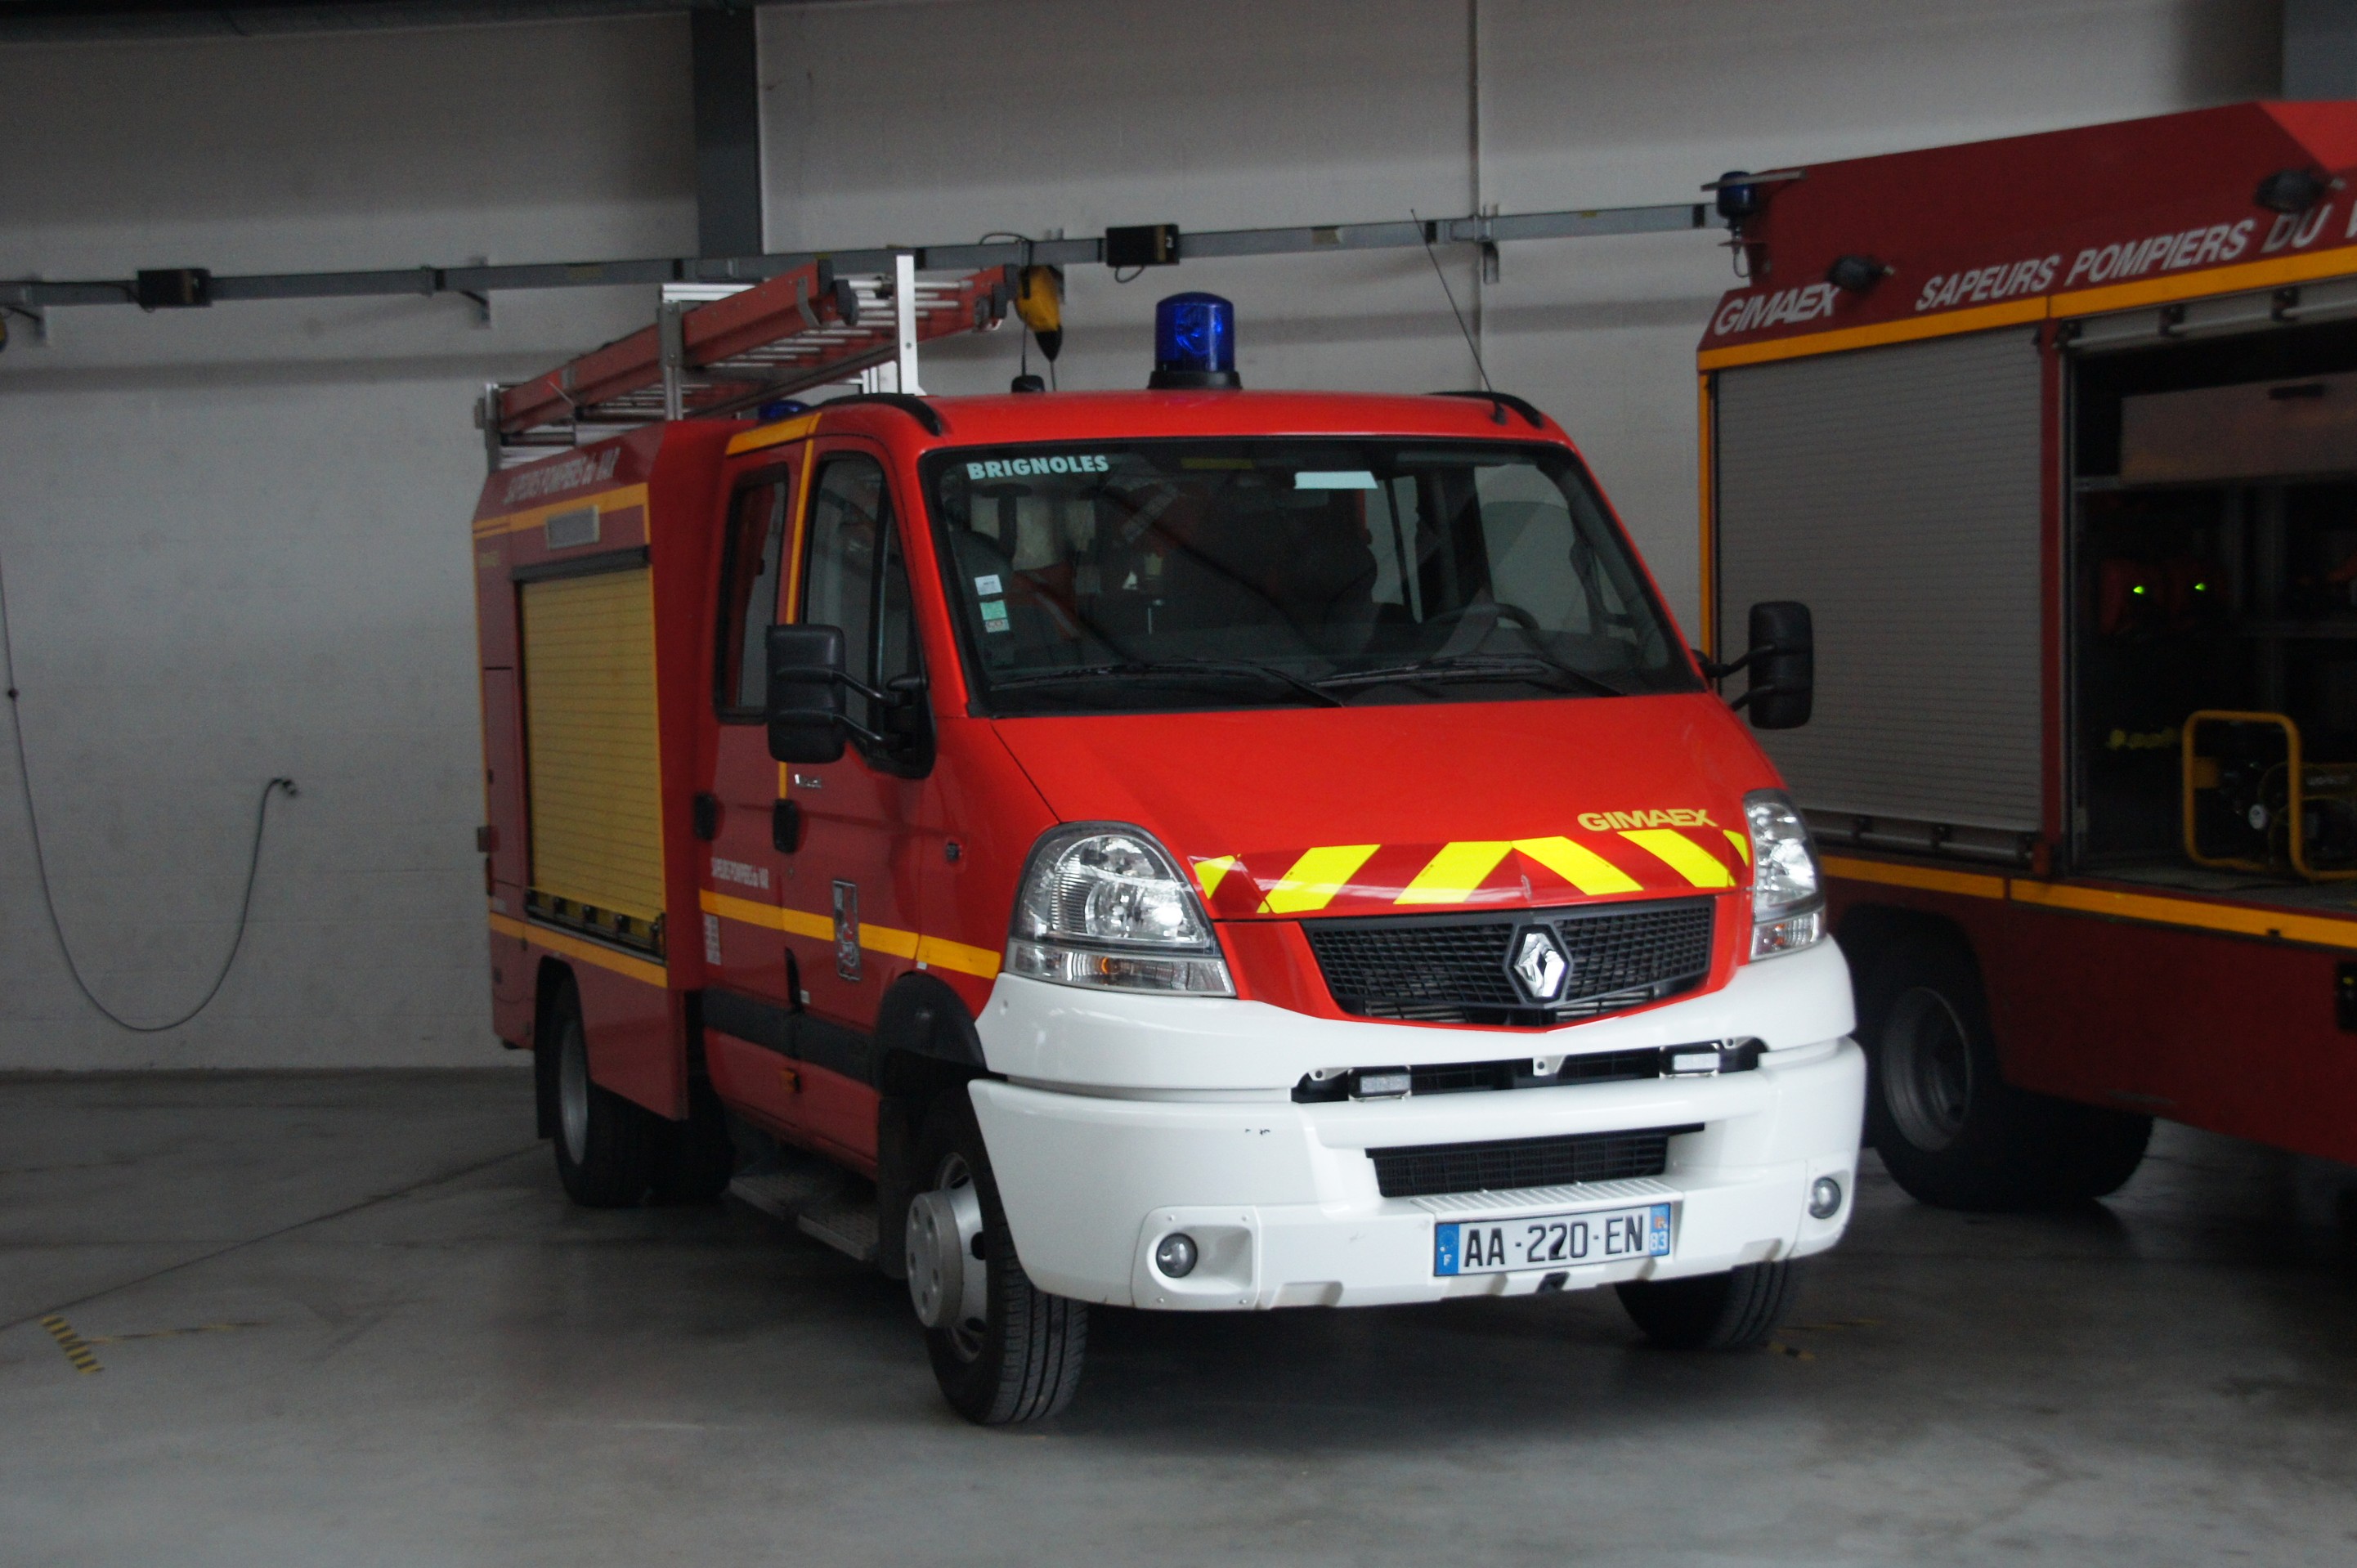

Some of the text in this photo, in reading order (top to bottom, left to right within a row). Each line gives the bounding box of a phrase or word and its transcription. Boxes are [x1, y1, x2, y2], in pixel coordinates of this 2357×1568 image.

[1915, 253, 2060, 311] SAPEURS
[2062, 217, 2255, 287] POMPIERS
[2261, 203, 2332, 253] DU
[1714, 282, 1839, 336] GIMAEX
[966, 455, 1109, 480] BRIGNOLES
[1577, 809, 1718, 831] GIMAEX
